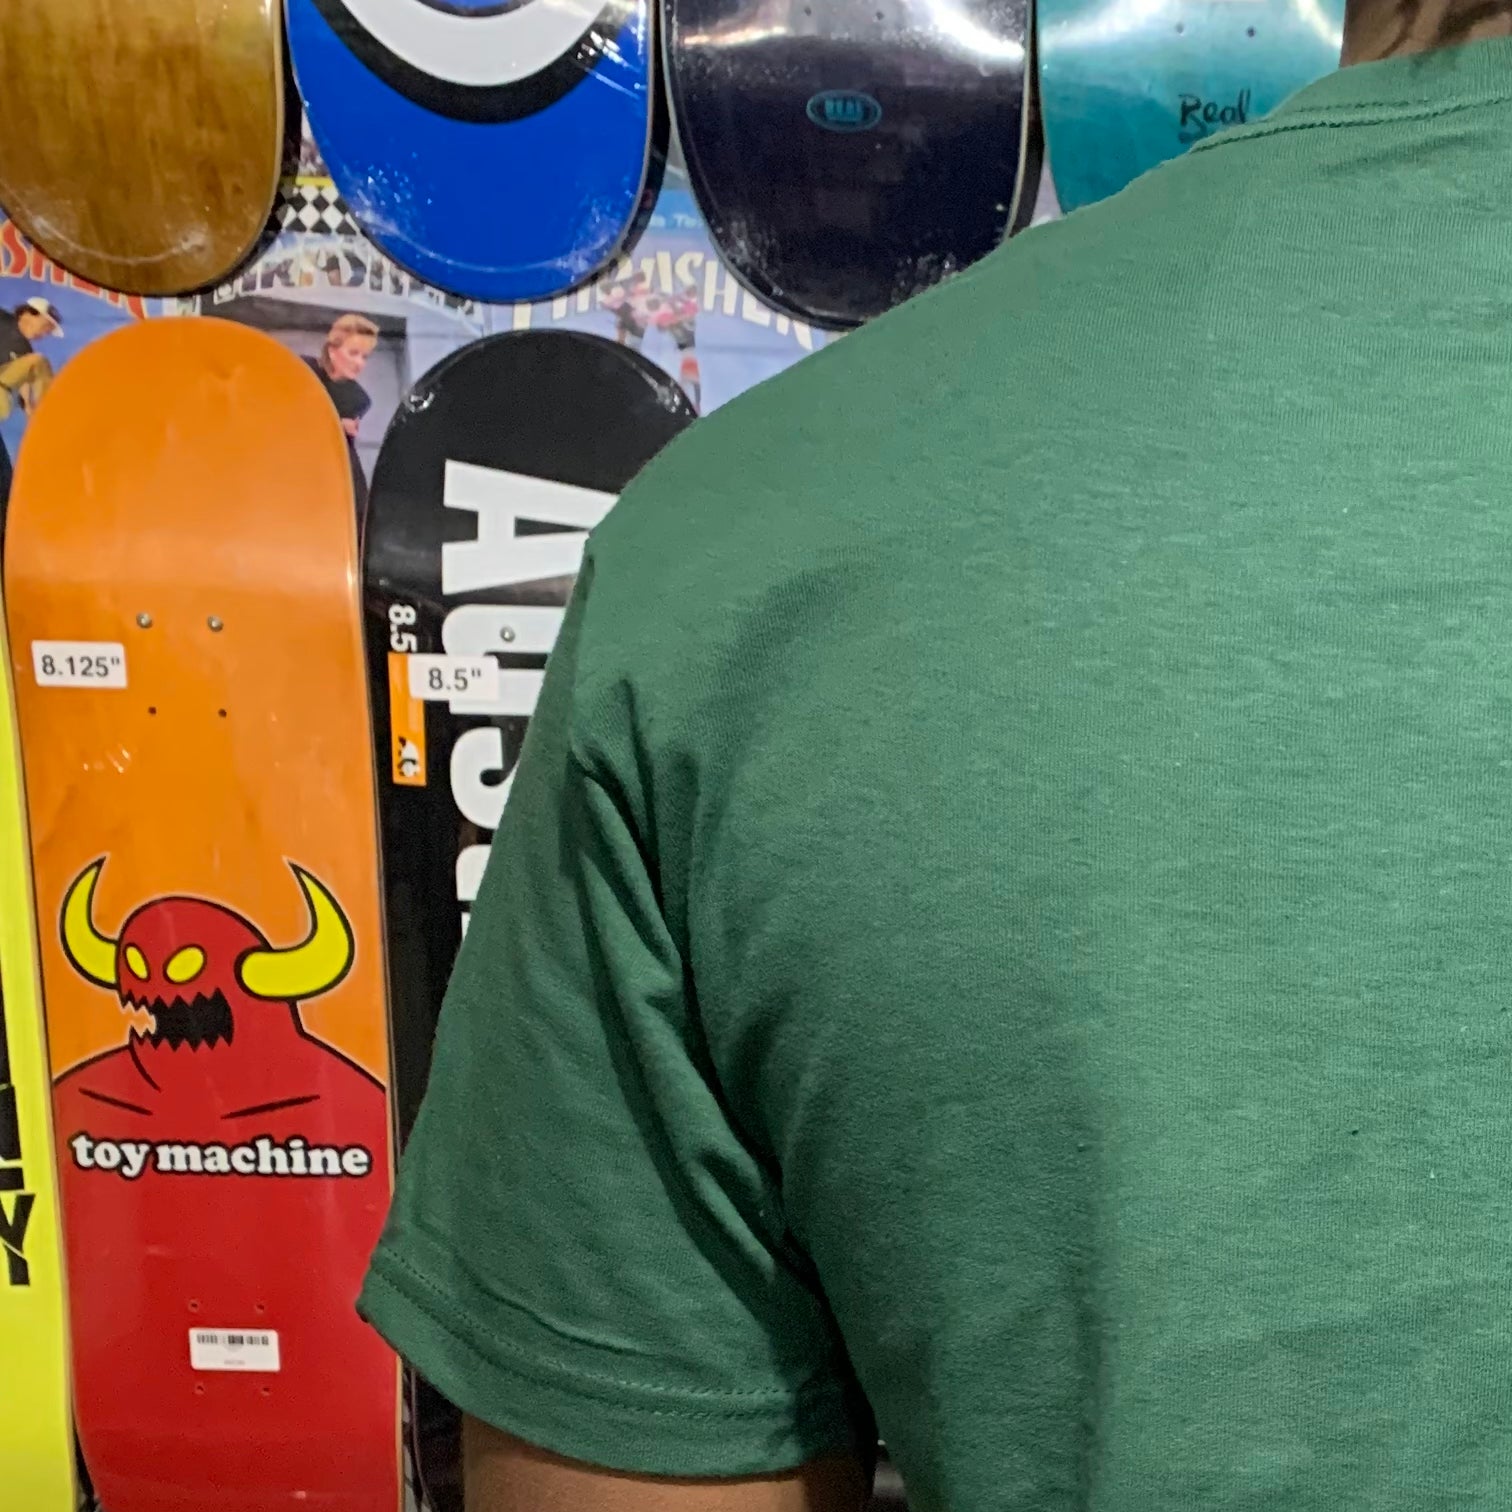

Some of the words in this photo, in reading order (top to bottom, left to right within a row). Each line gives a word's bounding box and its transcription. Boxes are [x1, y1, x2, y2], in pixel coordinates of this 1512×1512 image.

[1178, 88, 1251, 132] Real
[388, 603, 417, 653] 8.5
[41, 655, 121, 678] 8.125"
[428, 666, 483, 692] 8.5"
[72, 1134, 153, 1177] toy
[157, 1136, 370, 1176] machine
